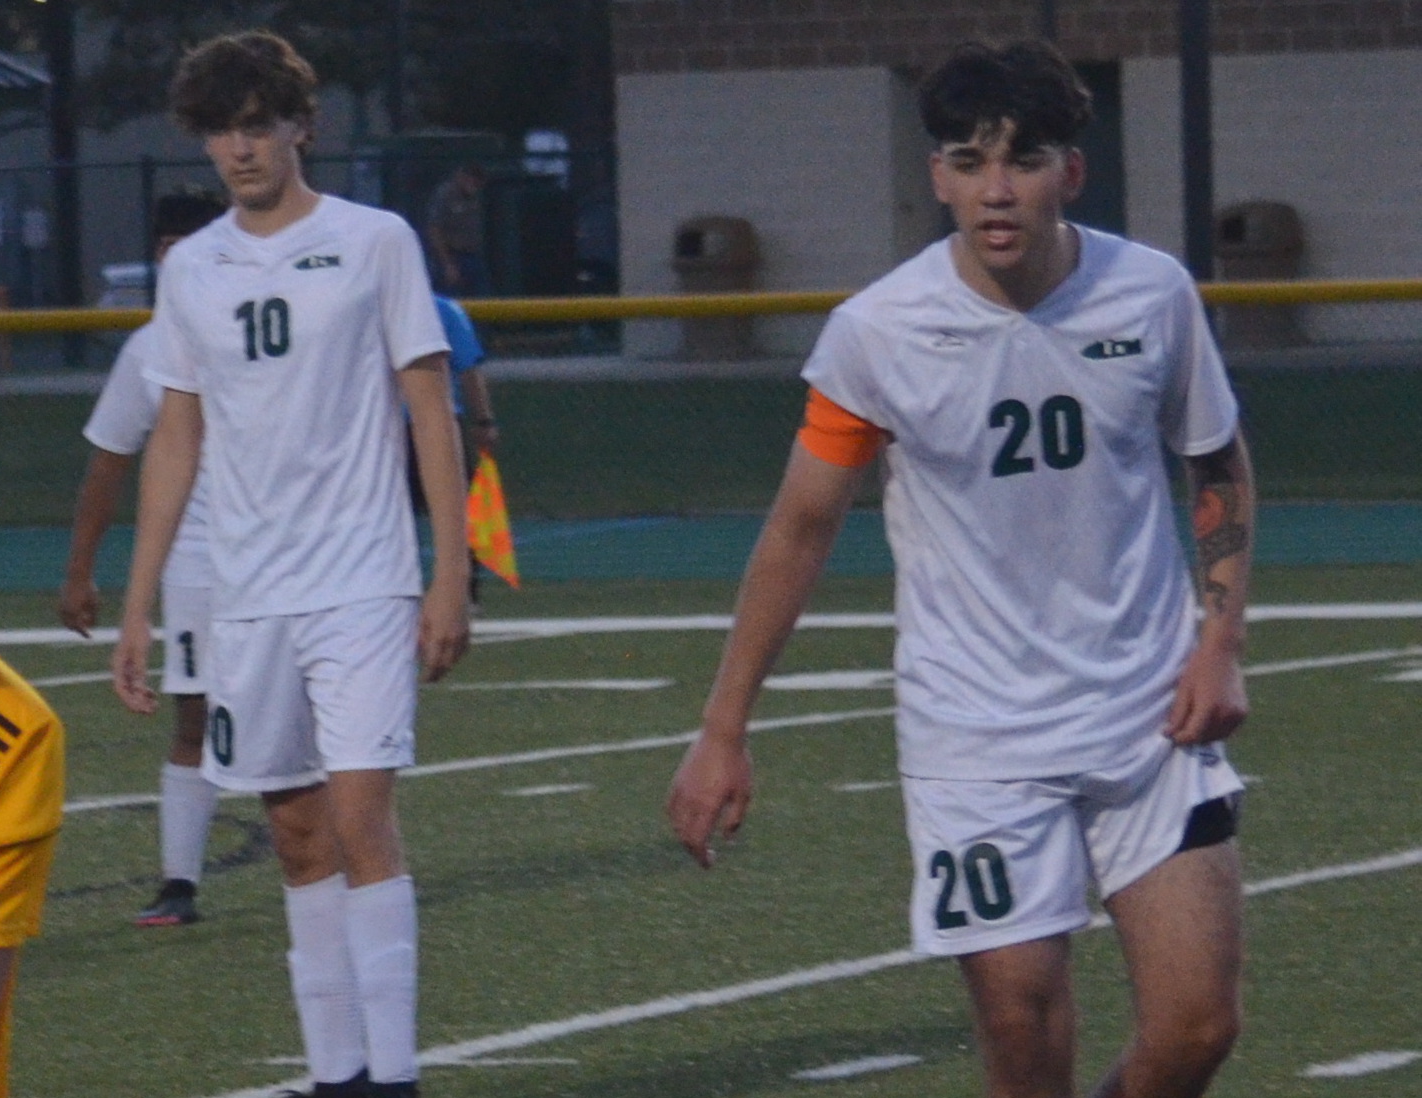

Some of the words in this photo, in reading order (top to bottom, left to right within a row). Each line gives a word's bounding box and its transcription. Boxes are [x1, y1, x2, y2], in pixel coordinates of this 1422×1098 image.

[235, 297, 289, 361] 10
[988, 395, 1085, 478] 20
[930, 843, 1014, 930] 20
